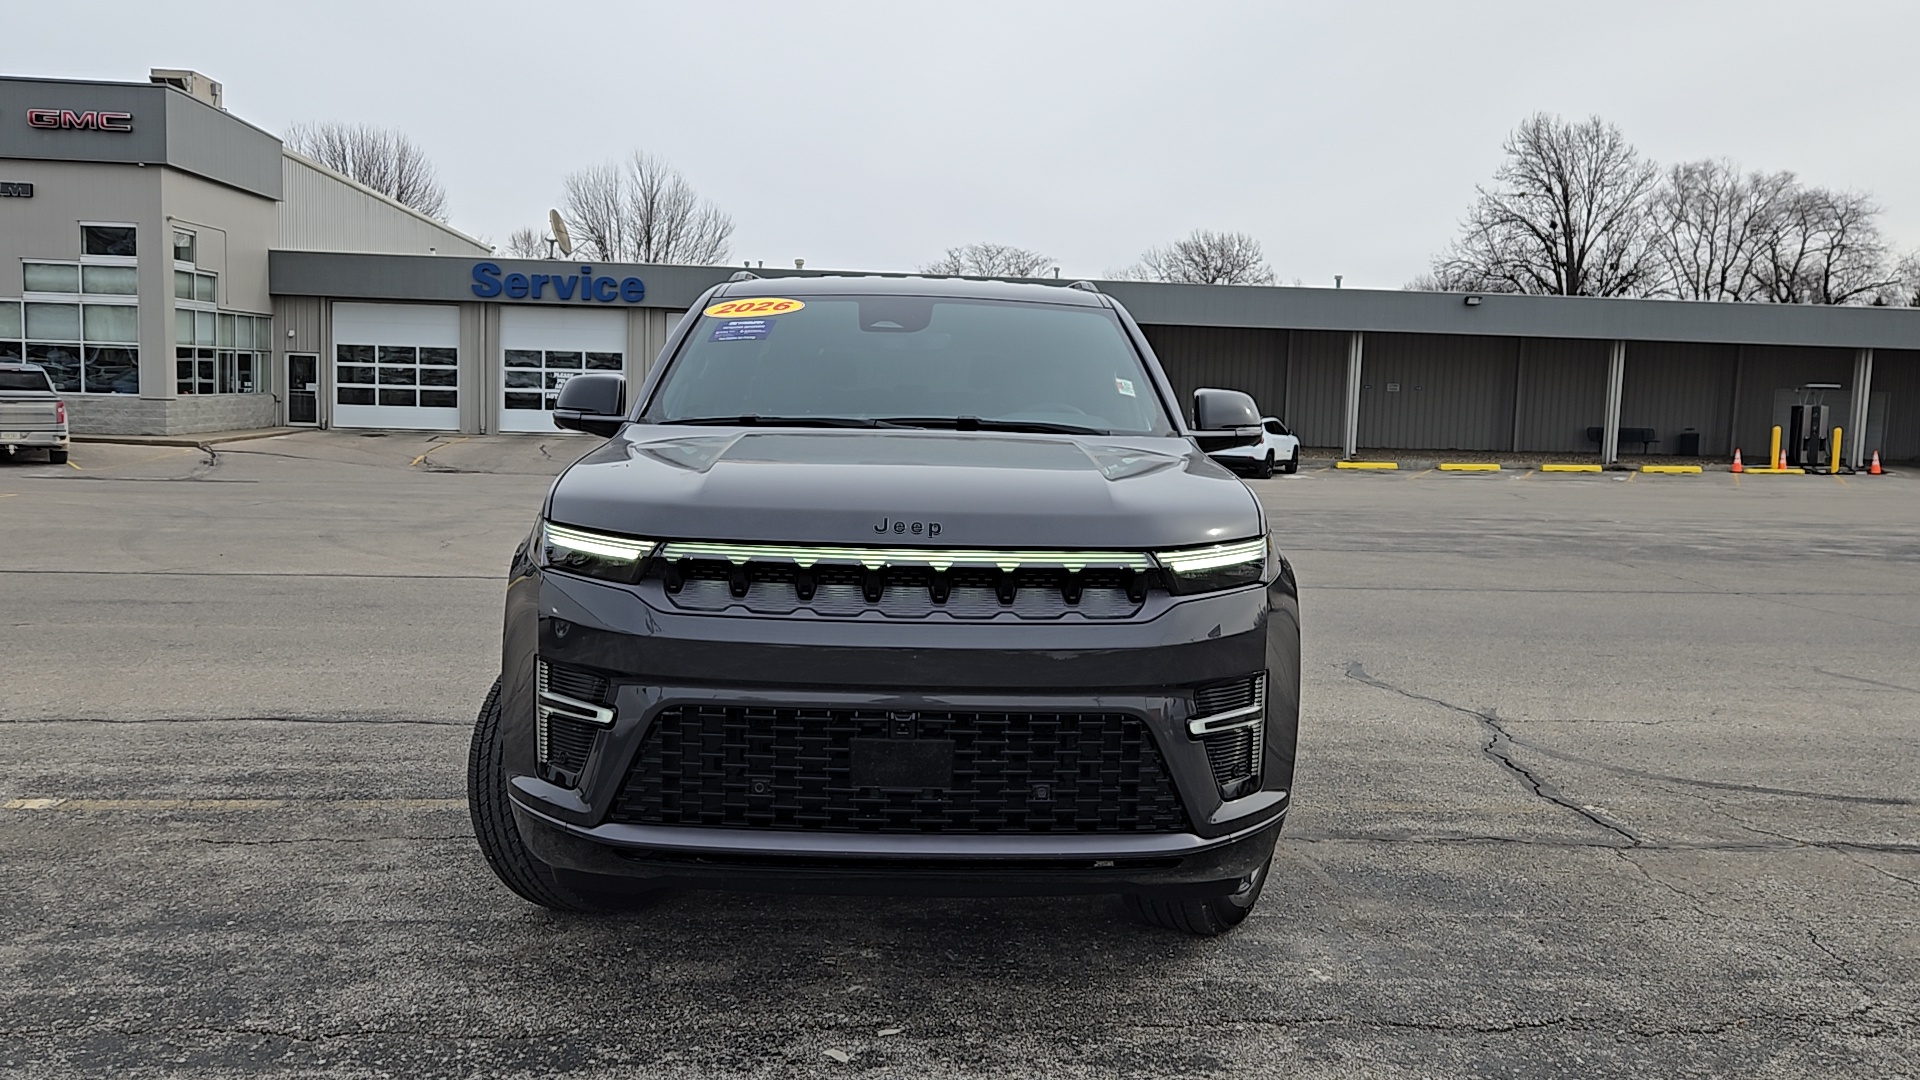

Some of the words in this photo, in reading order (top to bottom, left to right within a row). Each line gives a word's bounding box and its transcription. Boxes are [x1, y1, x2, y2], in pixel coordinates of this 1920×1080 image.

[27, 108, 132, 132] GMC
[471, 262, 645, 302] Service
[713, 301, 794, 314] 2026
[873, 517, 942, 538] Jeep
